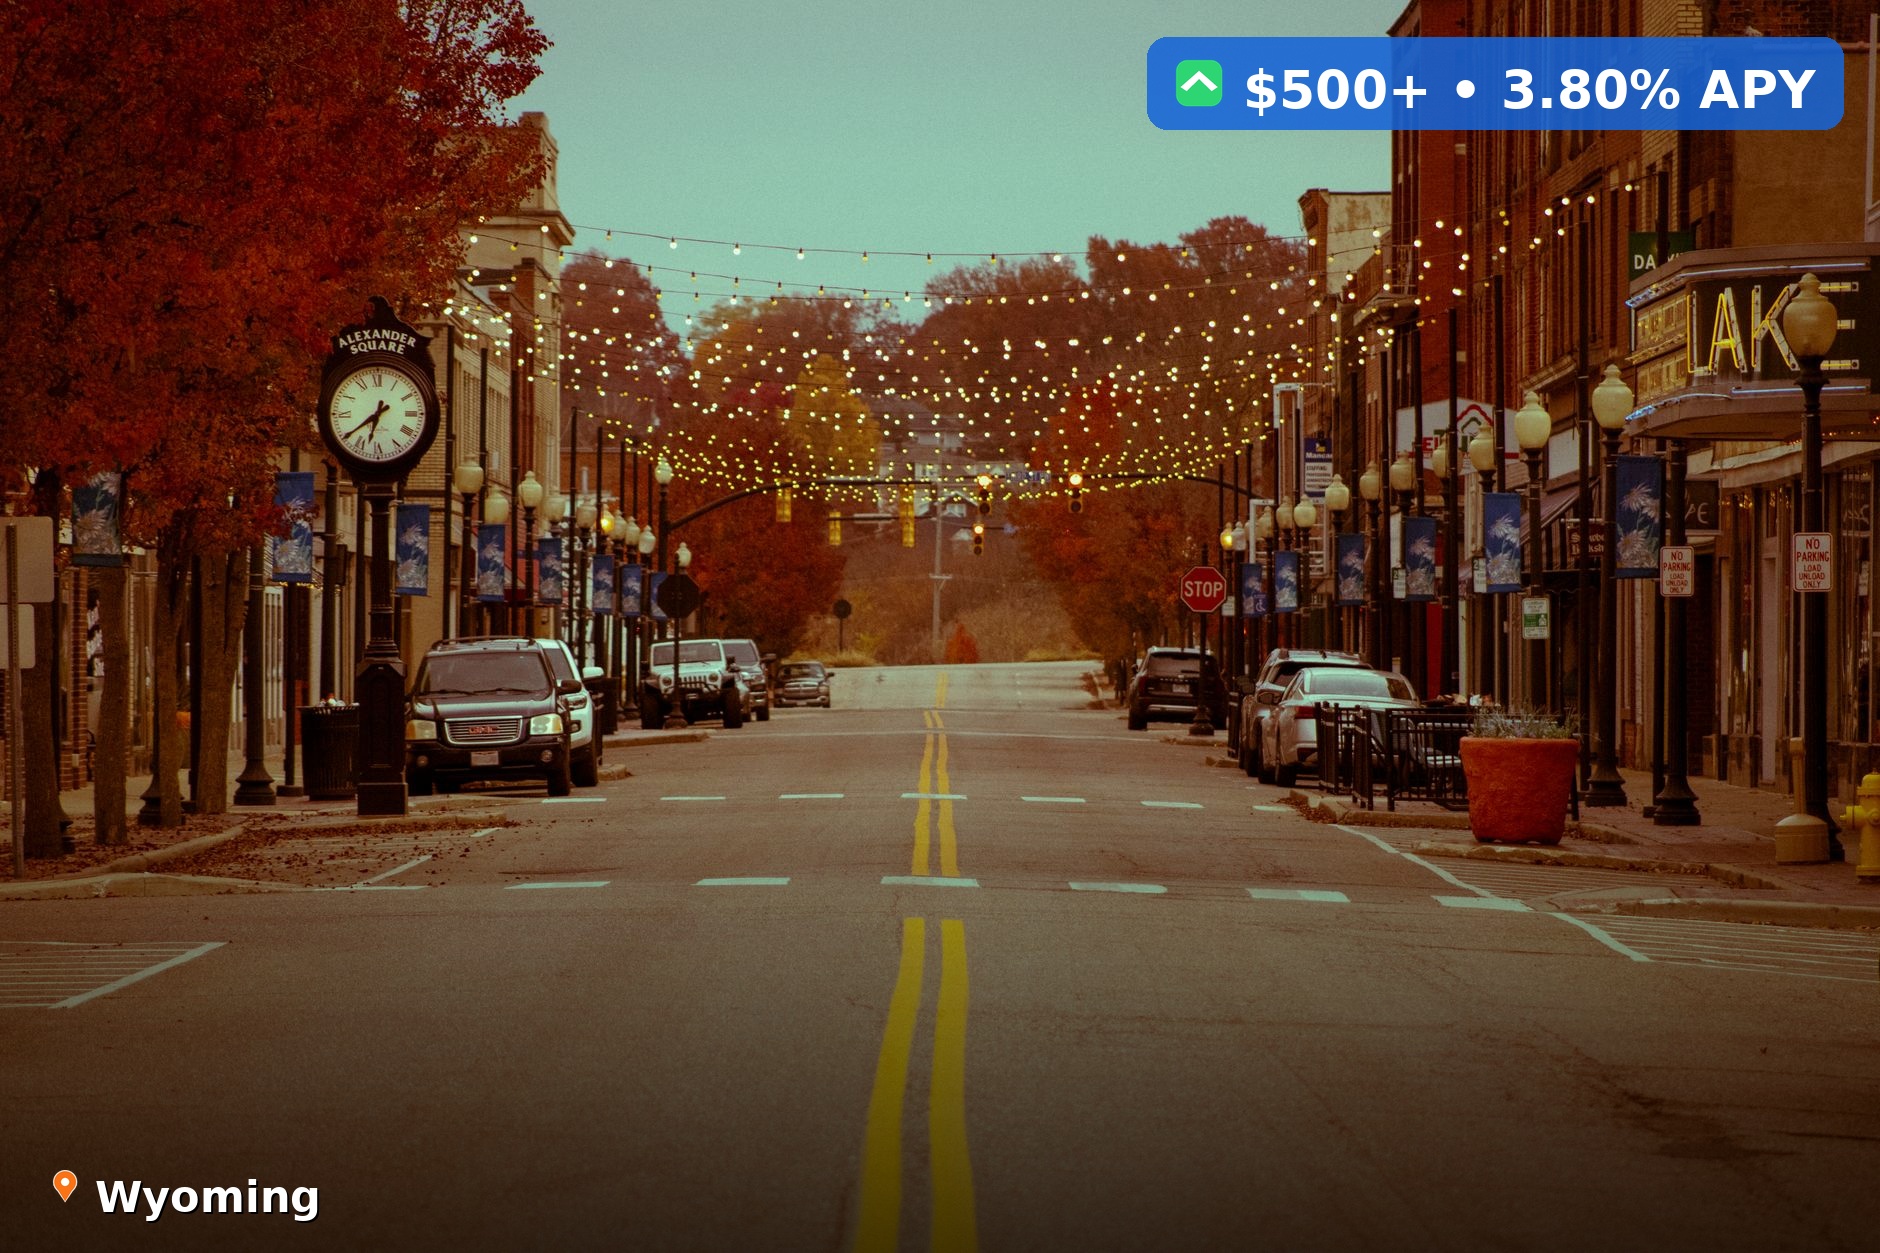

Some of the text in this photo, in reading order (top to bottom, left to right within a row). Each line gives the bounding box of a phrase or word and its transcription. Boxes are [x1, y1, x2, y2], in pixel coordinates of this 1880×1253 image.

[338, 328, 416, 349] ALEXANDER
[350, 339, 406, 355] SQUARE
[1805, 539, 1820, 550] NO
[1671, 552, 1683, 561] NO
[1796, 552, 1830, 562] PARKING
[1663, 562, 1691, 572] PARKING
[1804, 564, 1822, 572] LOAD
[1184, 581, 1223, 598] STOP
